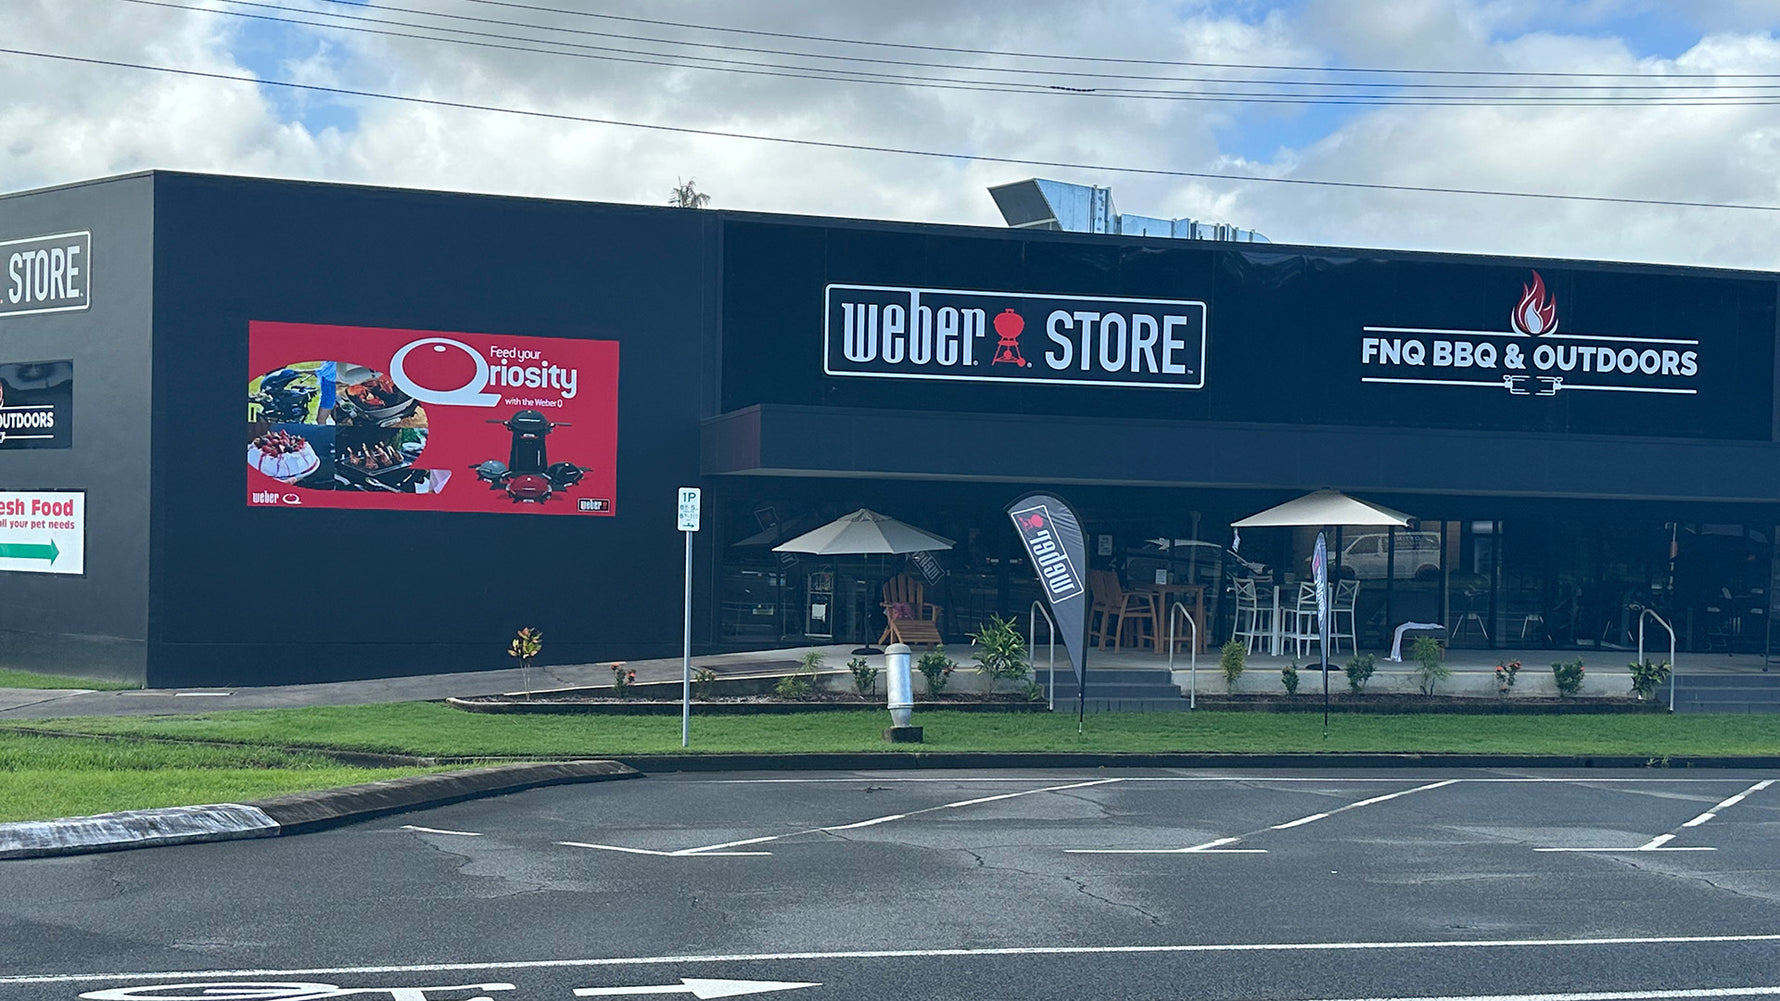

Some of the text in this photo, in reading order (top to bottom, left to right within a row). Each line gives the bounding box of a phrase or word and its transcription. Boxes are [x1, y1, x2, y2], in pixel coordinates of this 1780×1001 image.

[9, 245, 80, 304] STORE
[841, 289, 1187, 374] weber STORE
[490, 345, 542, 362] Feed your
[1362, 337, 1698, 376] FNQ BBQ & OUTDOORS
[504, 396, 521, 406] with
[522, 397, 534, 406] the
[535, 398, 556, 407] Weber
[252, 490, 280, 504] weber
[580, 499, 602, 510] weber
[682, 492, 696, 502] 1P
[31, 498, 74, 517] Food
[9, 519, 28, 529] your
[31, 519, 46, 529] pet
[48, 520, 75, 530] needs
